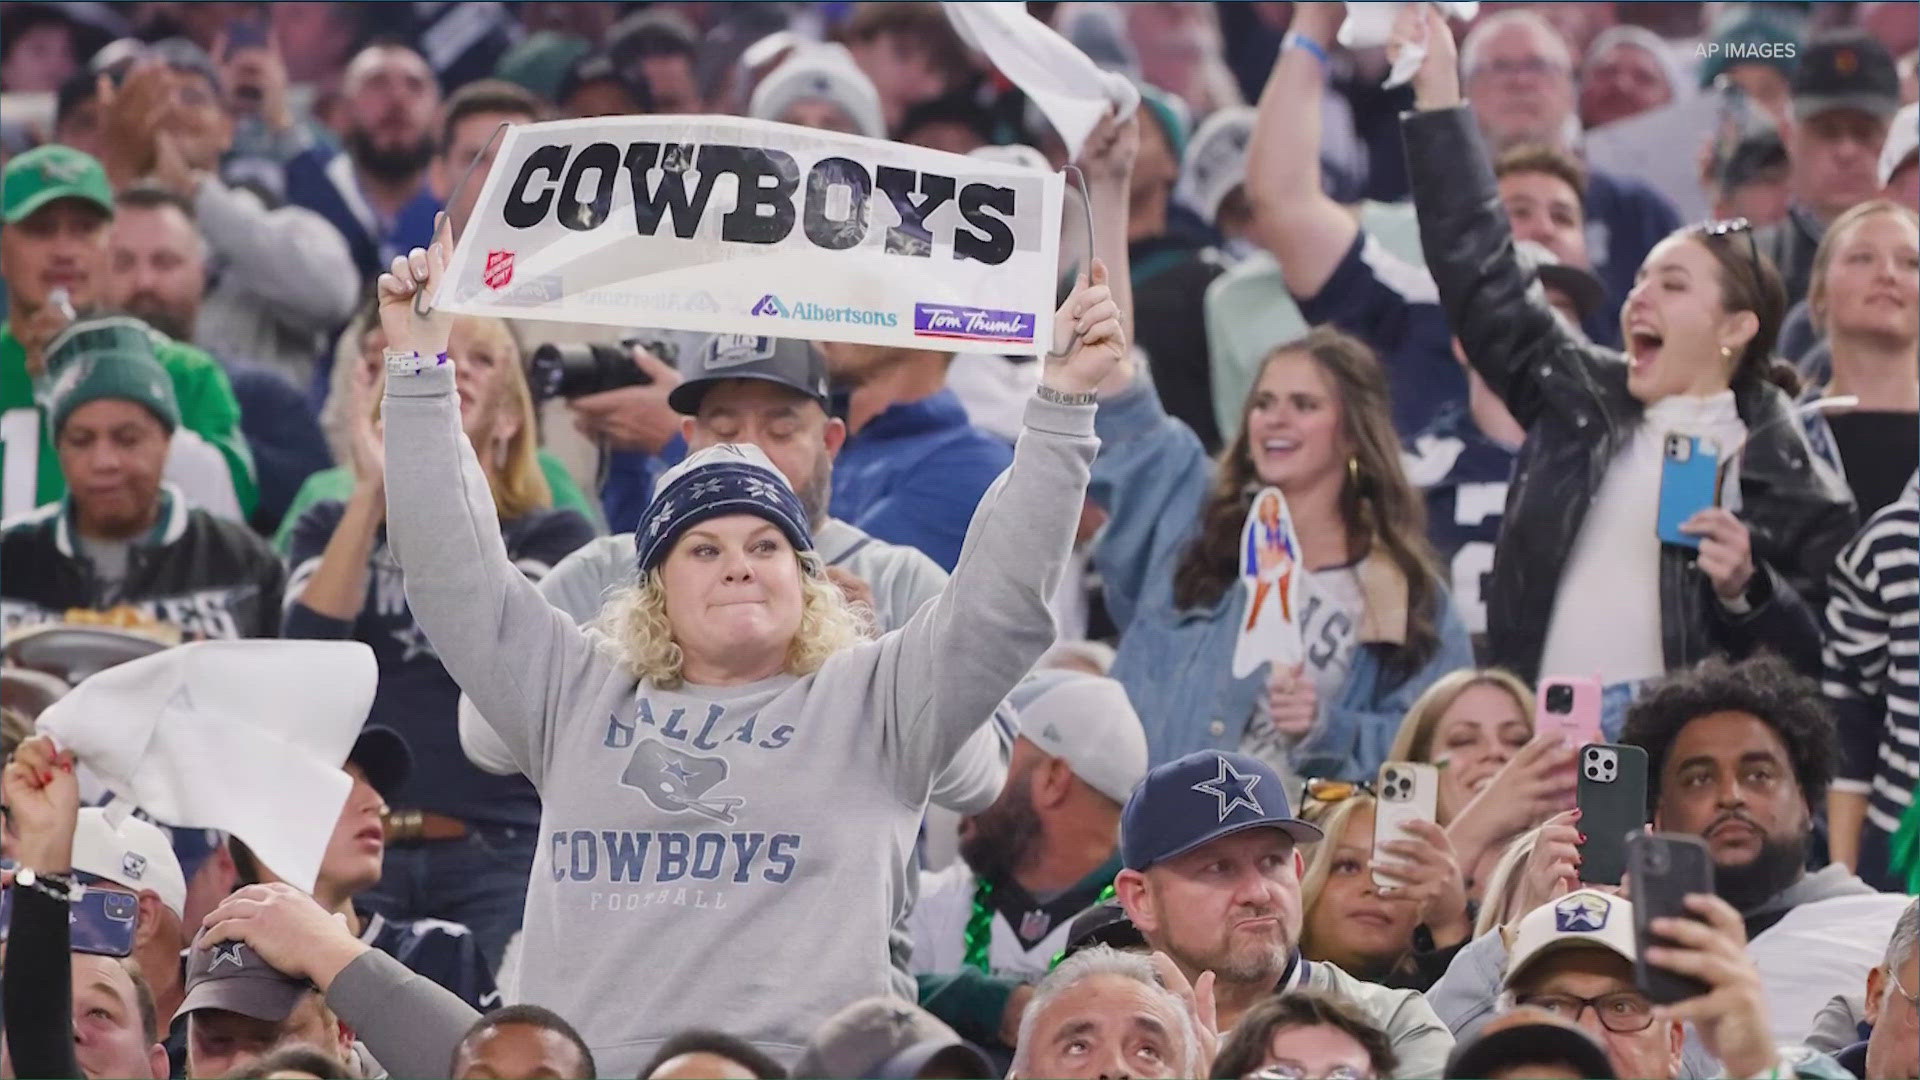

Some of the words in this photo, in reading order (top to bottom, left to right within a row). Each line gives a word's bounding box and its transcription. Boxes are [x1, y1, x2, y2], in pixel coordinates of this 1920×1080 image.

[503, 142, 1016, 266] COWBOYS
[791, 301, 898, 327] Albertsons
[922, 308, 962, 331] Tom
[963, 311, 1028, 333] Thumb
[603, 698, 796, 750] DALLAS
[551, 830, 801, 884] COWBOYS
[590, 888, 727, 911] FOOTBALL
